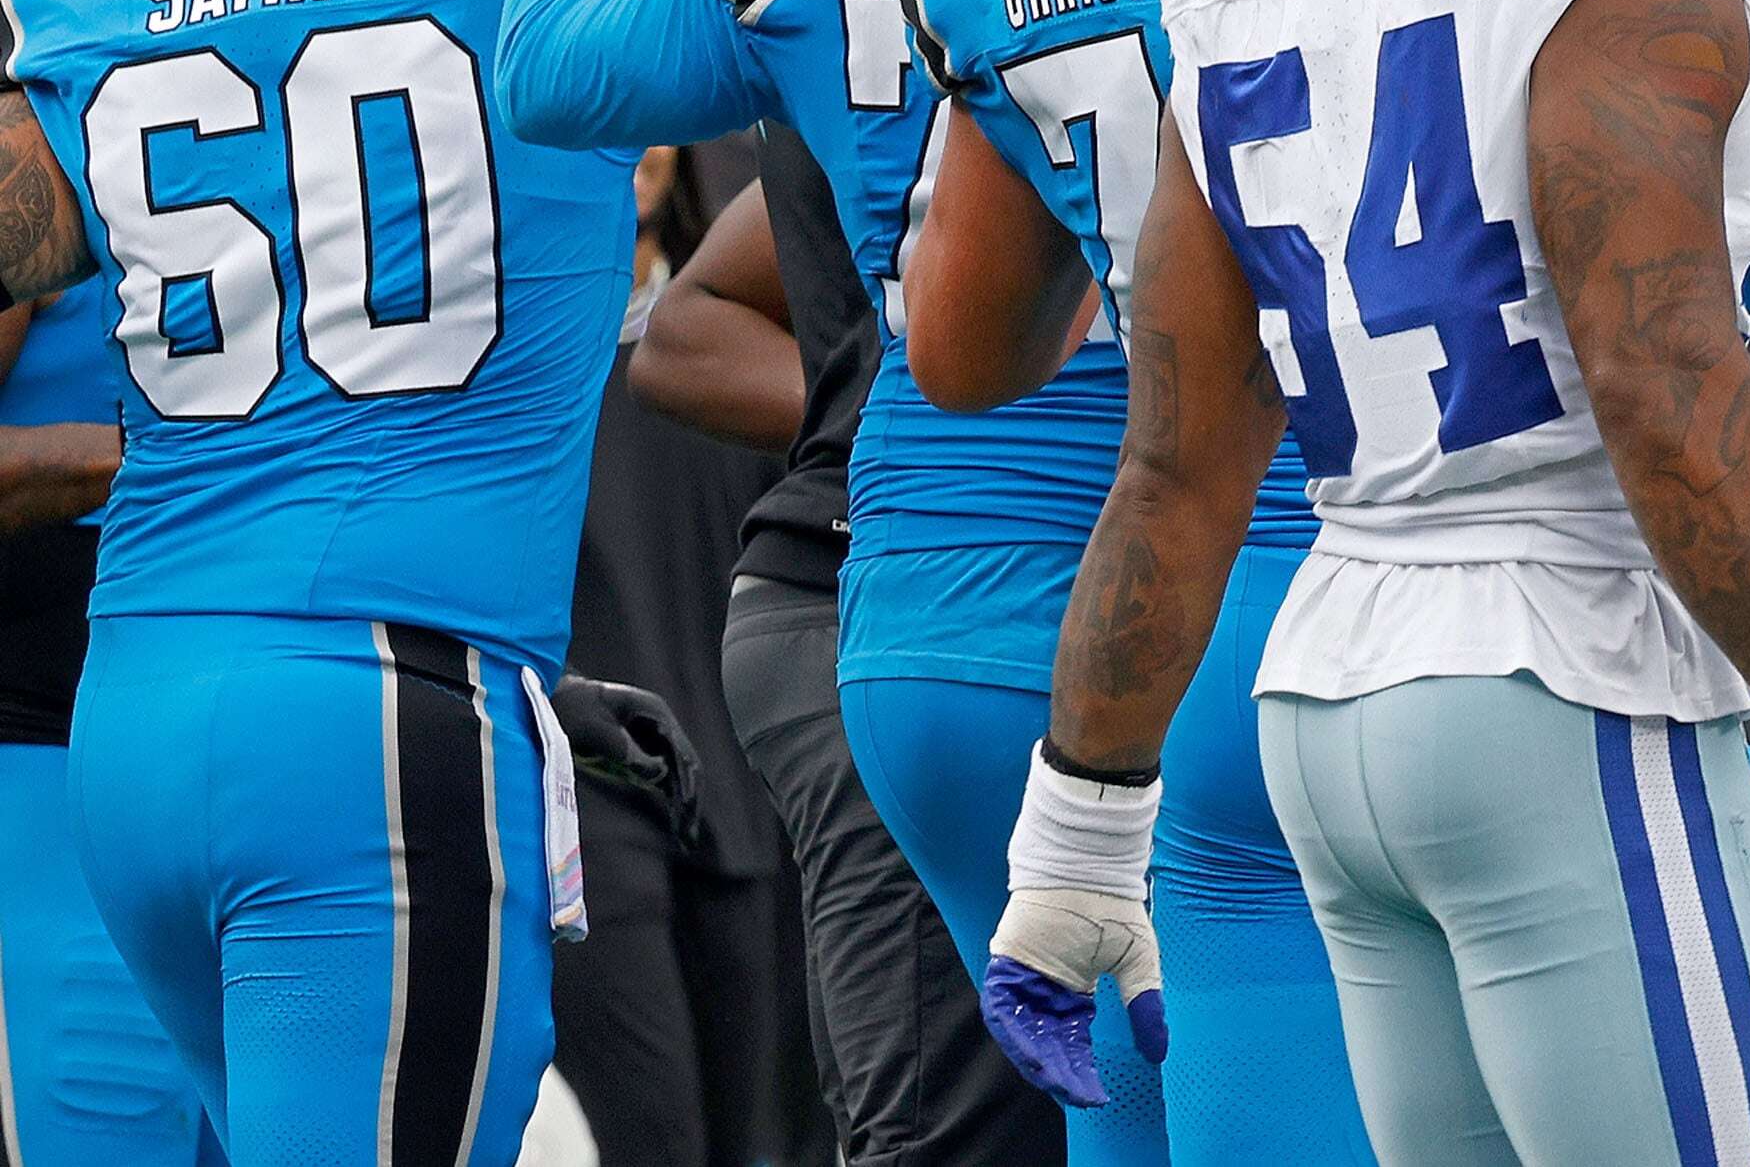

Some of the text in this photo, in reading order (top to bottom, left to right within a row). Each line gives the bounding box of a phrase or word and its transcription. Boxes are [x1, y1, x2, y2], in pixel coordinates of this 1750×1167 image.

[80, 13, 504, 421] 60
[993, 26, 1164, 363] 7
[1198, 13, 1566, 479] 54
